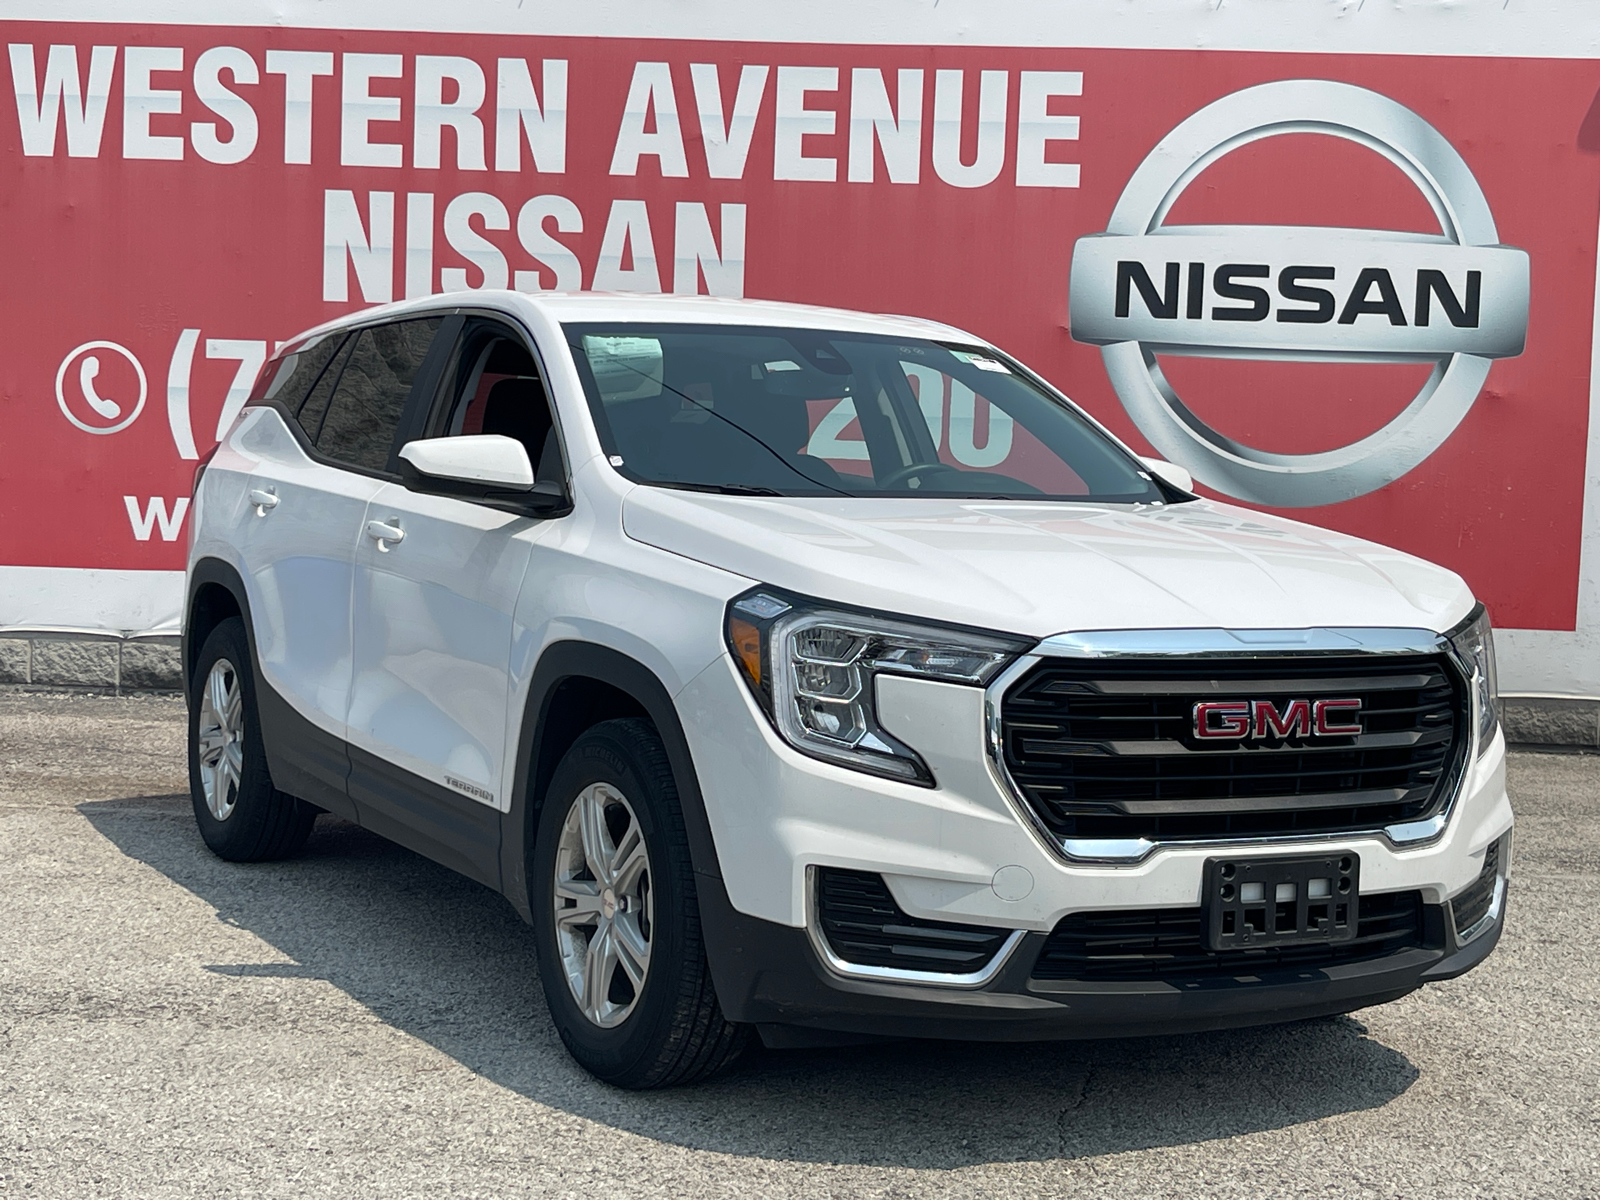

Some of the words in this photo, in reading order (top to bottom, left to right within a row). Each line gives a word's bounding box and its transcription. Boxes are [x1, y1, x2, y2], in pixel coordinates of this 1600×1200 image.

[8, 43, 568, 174] WESTERN
[609, 61, 1083, 188] AVENUE
[323, 189, 747, 303] NISSAN
[1114, 260, 1481, 328] NISSAN
[1193, 698, 1362, 739] GMC
[444, 775, 494, 803] TERRAIN
